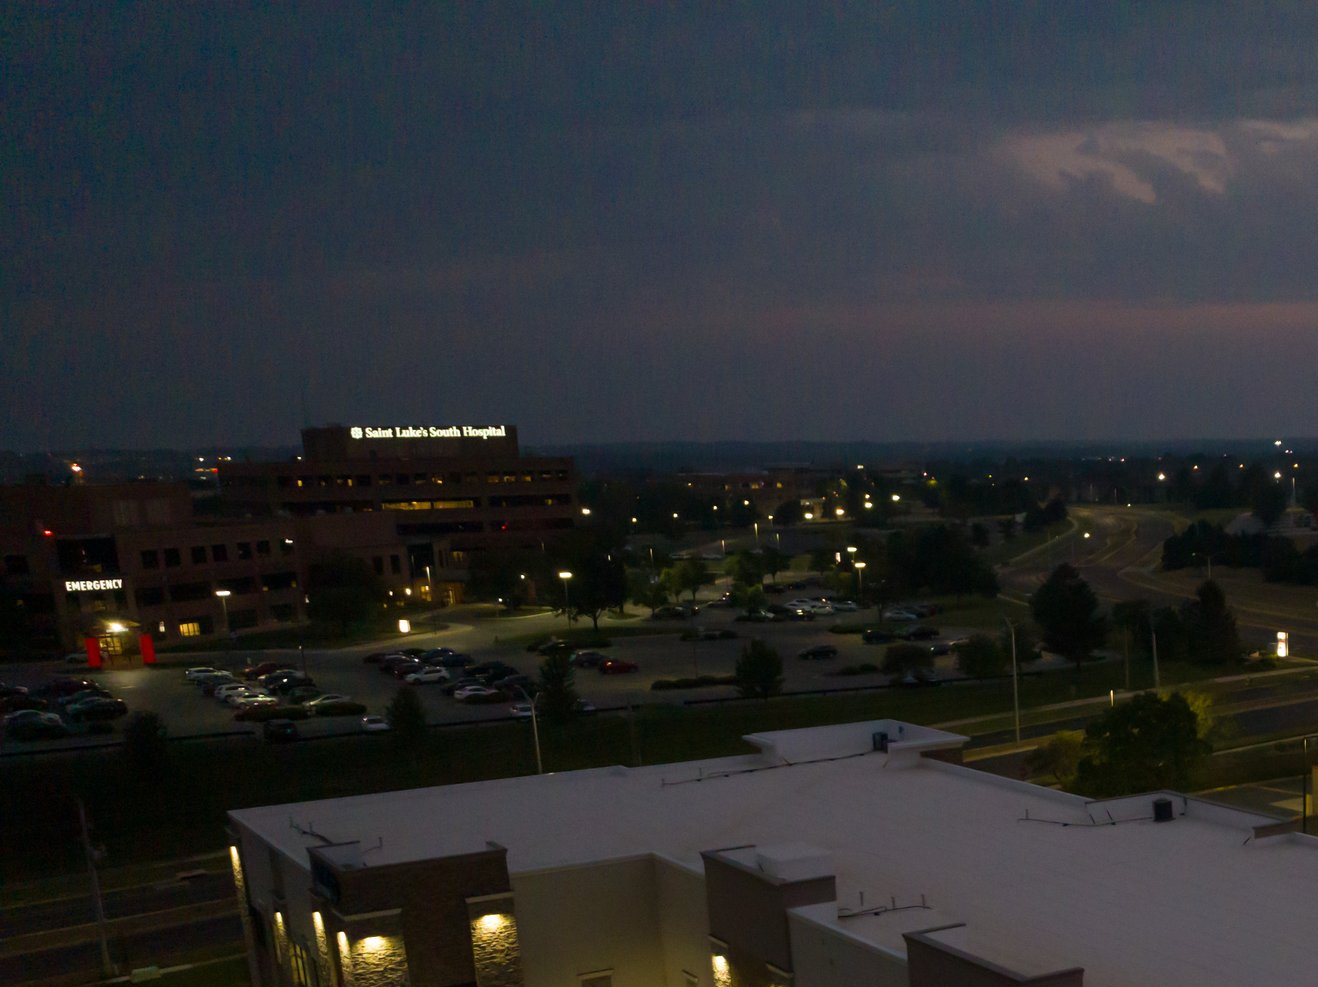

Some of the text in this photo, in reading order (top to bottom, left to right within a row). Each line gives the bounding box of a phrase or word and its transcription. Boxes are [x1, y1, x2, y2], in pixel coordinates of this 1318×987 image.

[365, 425, 506, 440] Saint Luke's South Hospital
[65, 579, 122, 591] EMERGENCY
